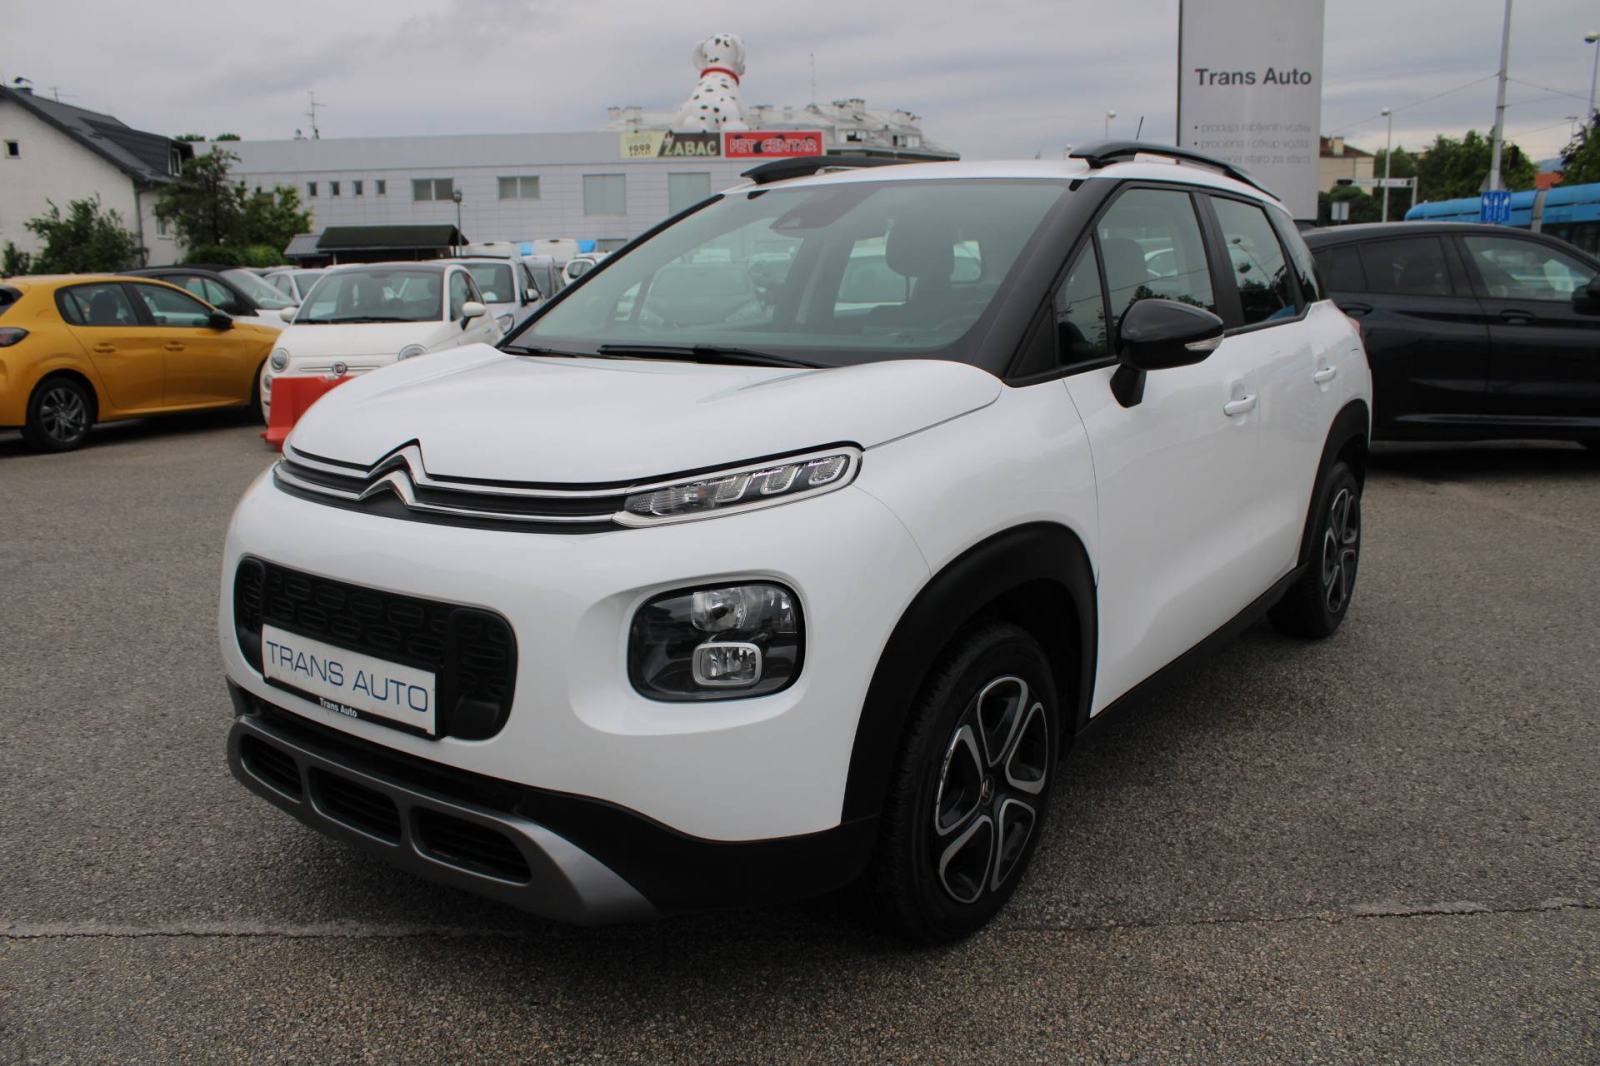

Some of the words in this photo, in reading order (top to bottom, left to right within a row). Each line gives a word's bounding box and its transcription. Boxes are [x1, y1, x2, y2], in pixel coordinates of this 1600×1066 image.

[1195, 68, 1256, 86] Trans
[1263, 67, 1312, 85] Auto
[729, 138, 756, 153] PET
[760, 138, 817, 153] CENTAR
[266, 640, 344, 687] TRANS
[352, 670, 428, 713] AUTO
[319, 697, 340, 712] Trans
[340, 704, 358, 719] Auto
